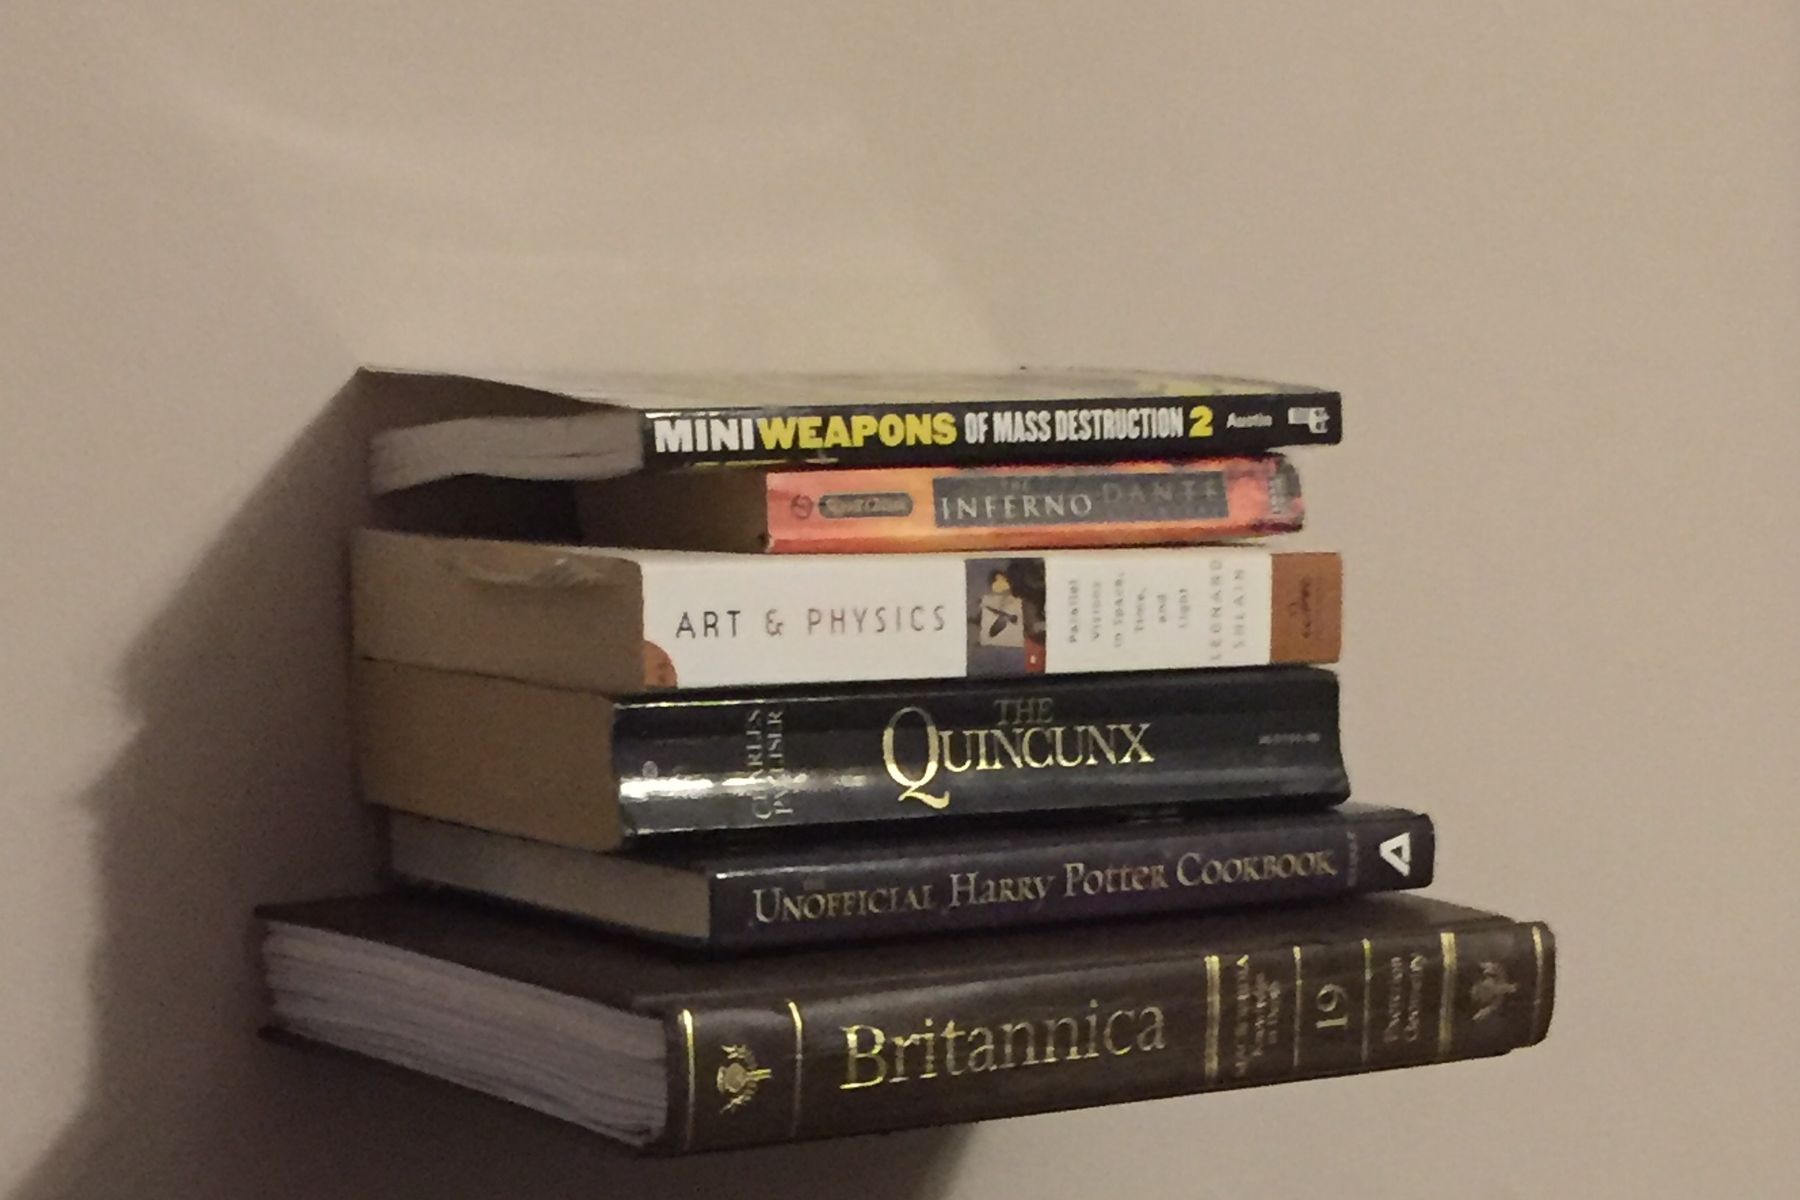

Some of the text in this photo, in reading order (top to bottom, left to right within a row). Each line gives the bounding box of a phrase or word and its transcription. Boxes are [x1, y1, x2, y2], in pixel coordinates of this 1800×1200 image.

[653, 405, 1214, 453] MINI WEAPONS OF MASS DESTRUCTION 2
[941, 493, 1093, 520] INFERNO
[1102, 480, 1218, 504] DANTE
[676, 605, 946, 639] ART & PHYSICS
[1209, 558, 1224, 662] LEONARD
[996, 697, 1054, 725] THE
[882, 706, 1155, 810] QUINCUNX
[752, 884, 934, 924] UNOFFICIAL
[1176, 852, 1338, 887] COOKBOOK
[1315, 983, 1349, 1030] 19
[839, 998, 1166, 1091] Britannica
